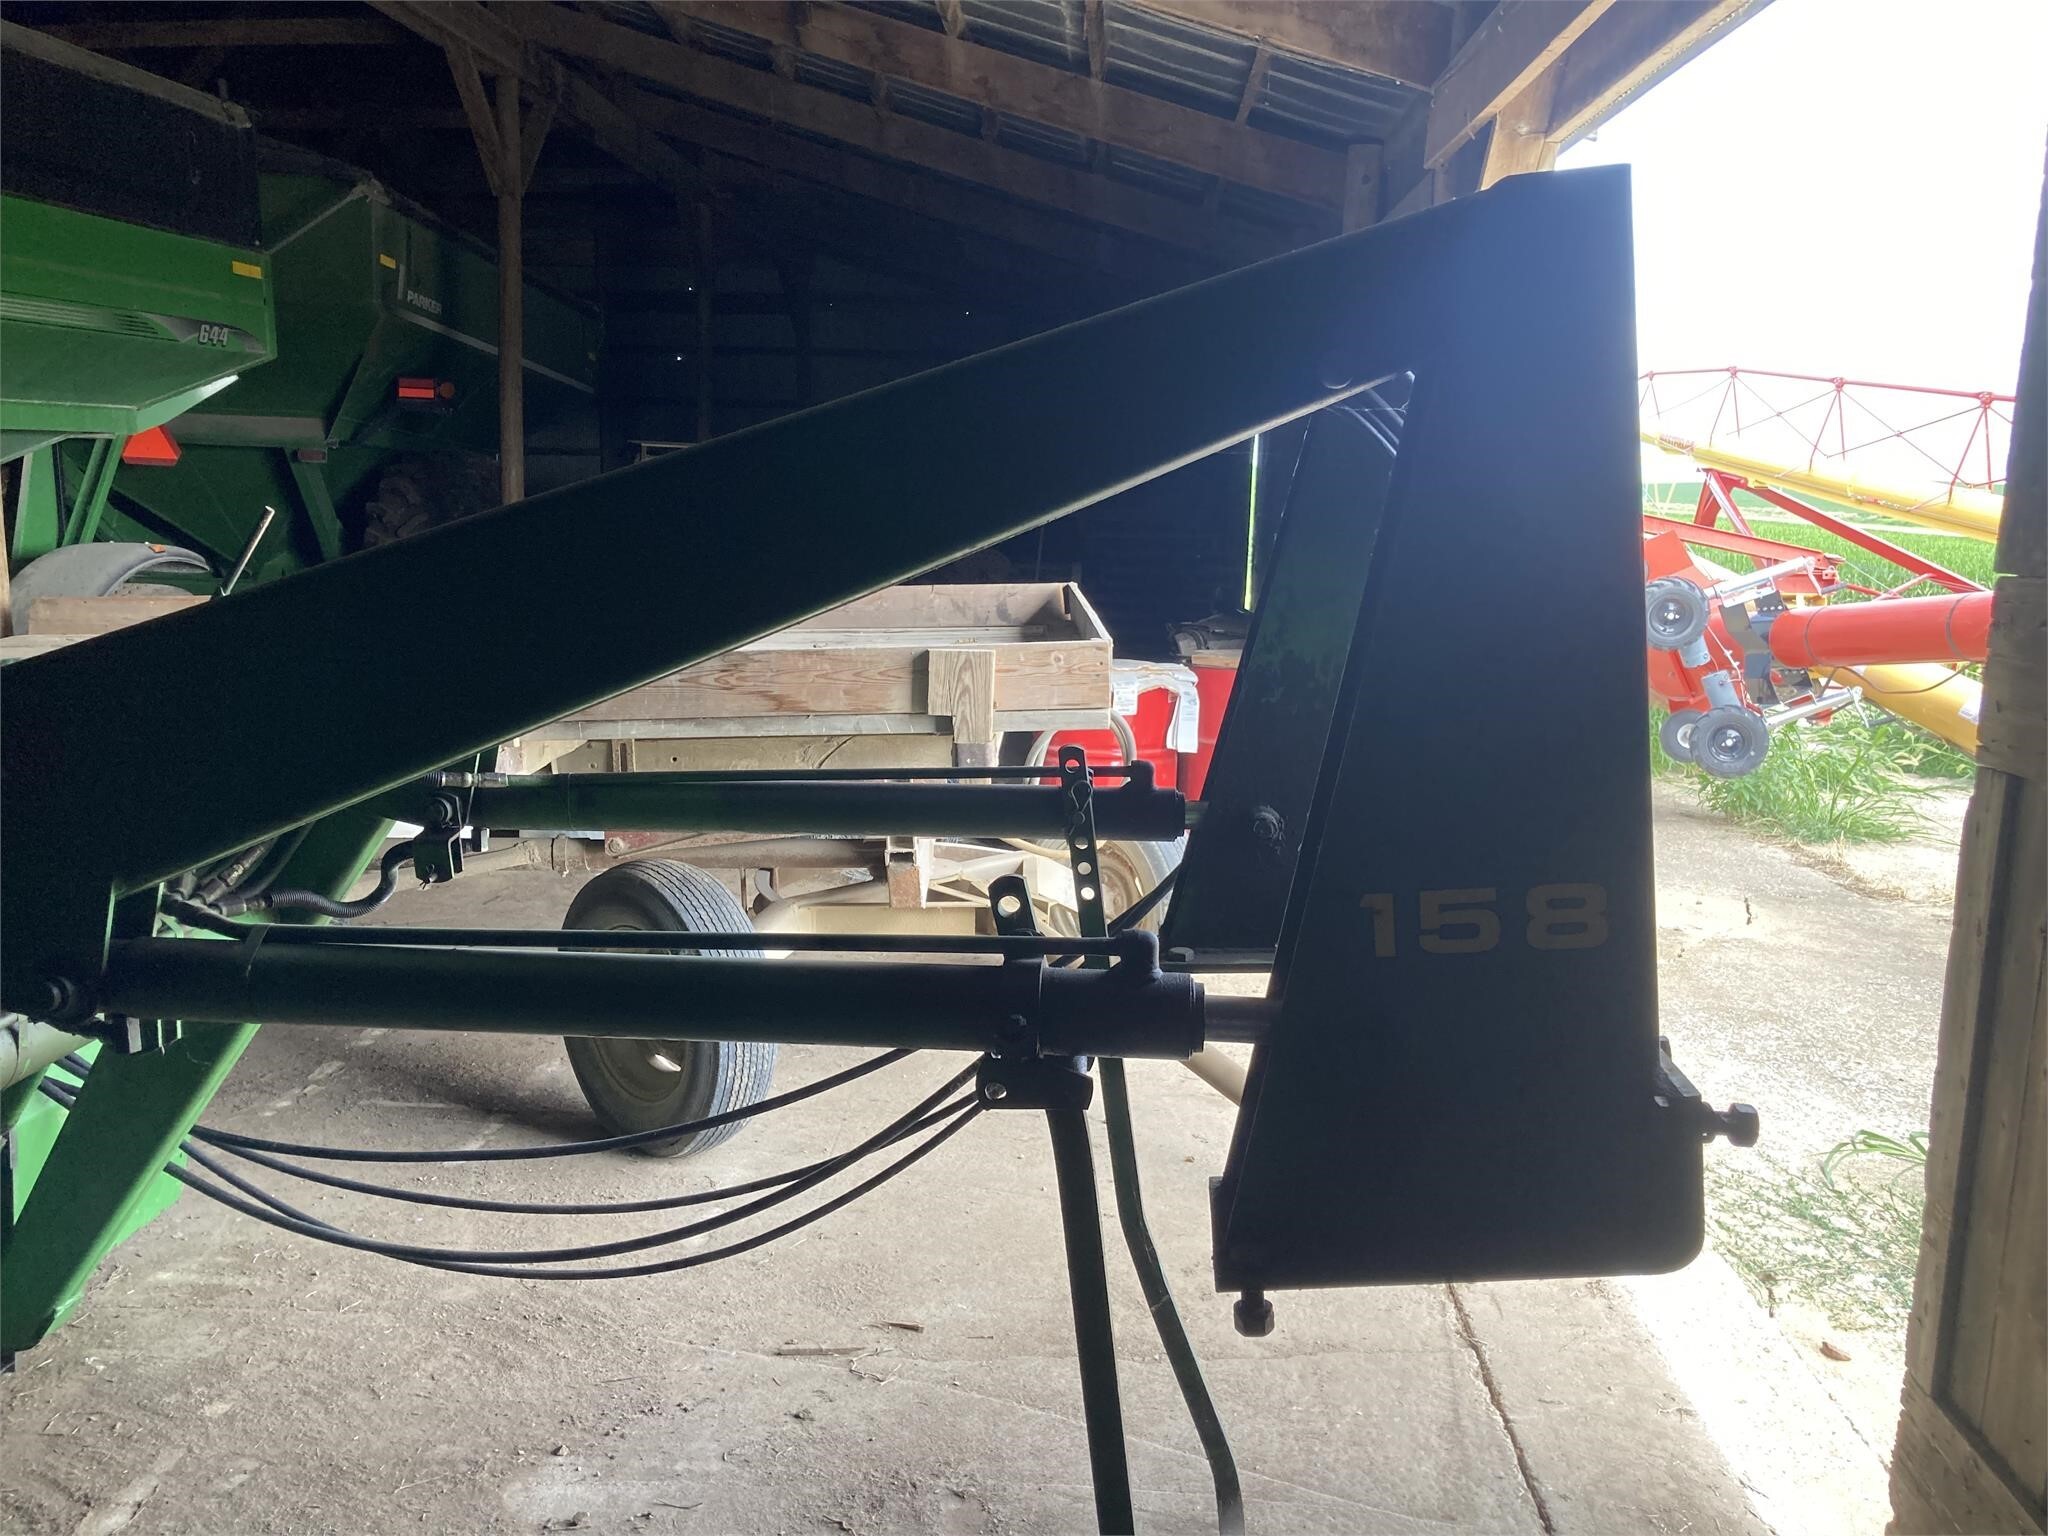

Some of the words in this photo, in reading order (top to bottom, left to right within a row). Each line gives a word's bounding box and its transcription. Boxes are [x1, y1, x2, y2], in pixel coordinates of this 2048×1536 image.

[407, 290, 443, 315] PARKER
[199, 324, 229, 346] 644
[1359, 883, 1609, 957] 158
